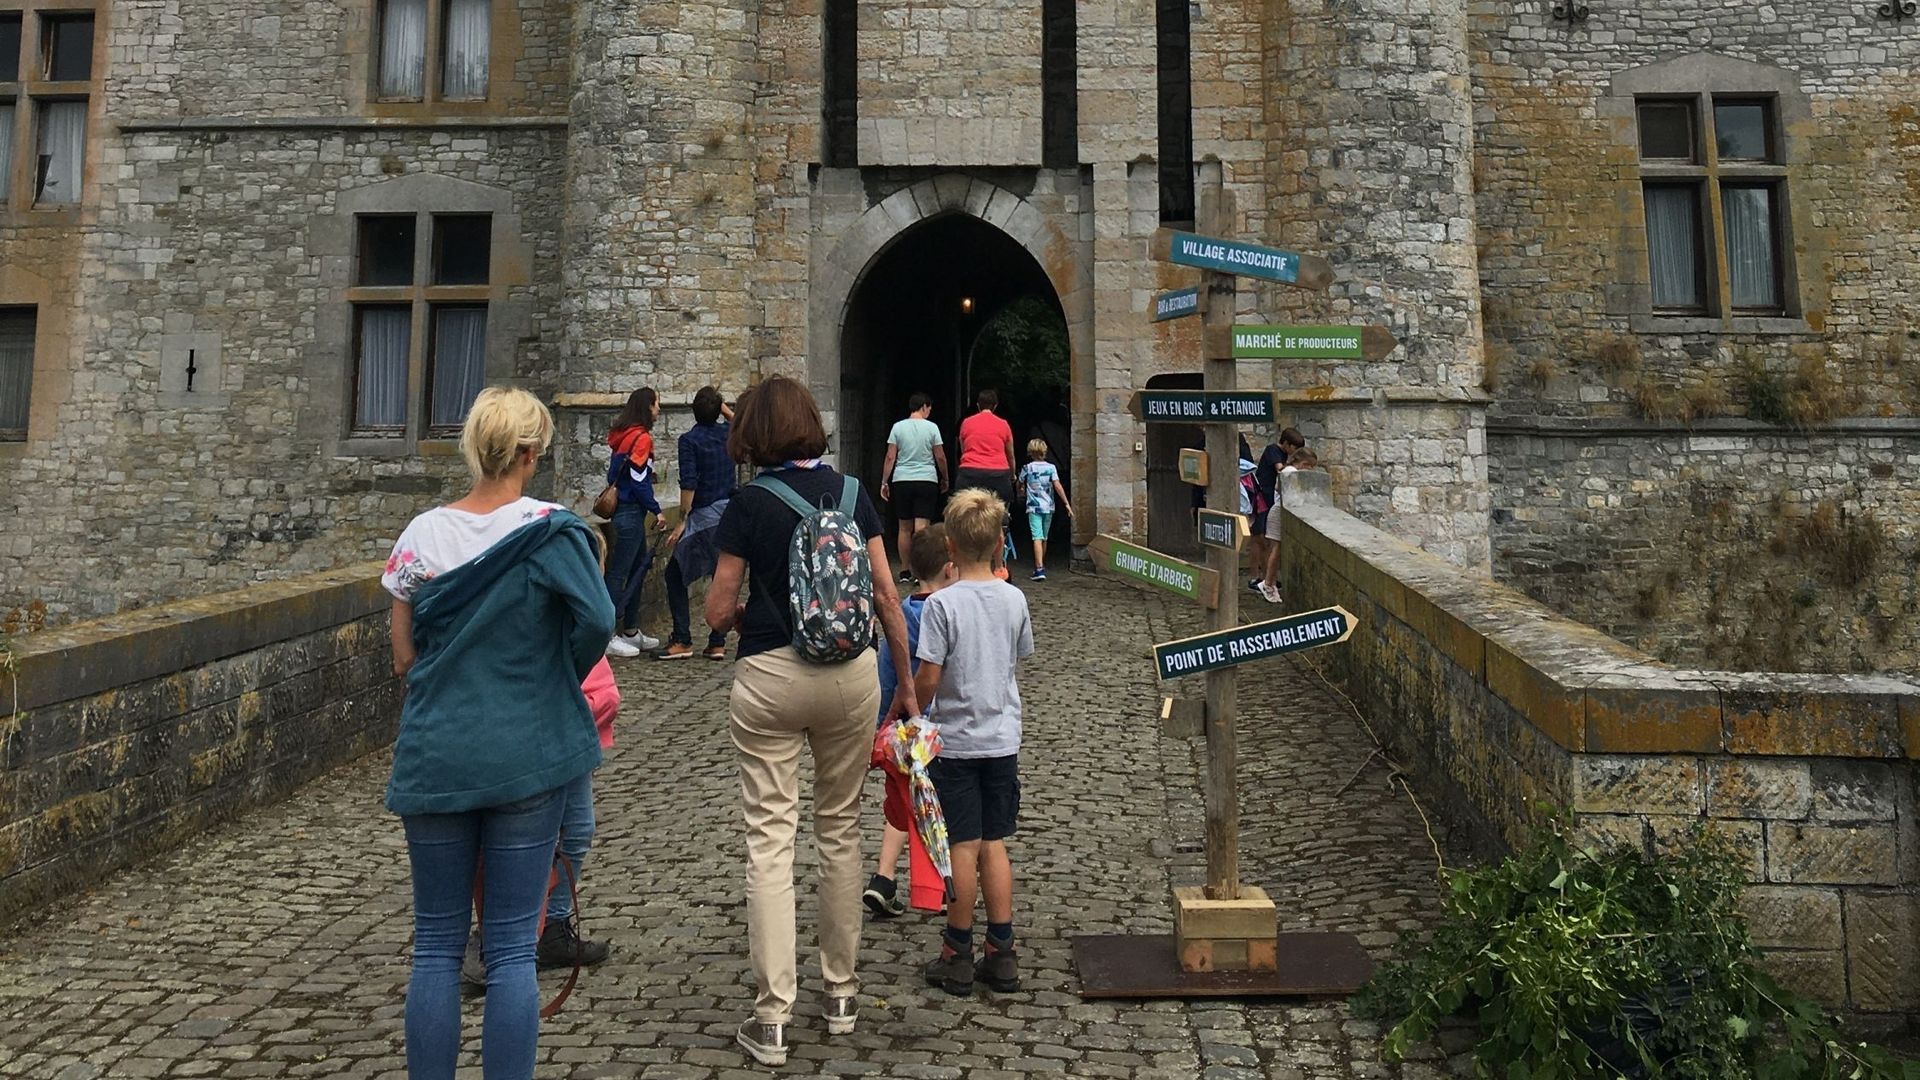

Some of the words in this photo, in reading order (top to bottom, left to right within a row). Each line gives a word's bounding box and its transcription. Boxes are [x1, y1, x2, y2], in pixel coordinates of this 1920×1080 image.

[1182, 240, 1225, 260] VILLAGE
[1227, 248, 1288, 271] ASSOCIATIF
[1235, 332, 1282, 349] MARCHÉ
[1285, 338, 1297, 349] DE
[1298, 338, 1358, 349] PRODUCTEURS
[1148, 400, 1168, 415] JEUX
[1169, 401, 1181, 415] EN
[1183, 401, 1204, 416] BOIS
[1210, 402, 1219, 415] &
[1220, 398, 1267, 416] PÉTANQUE
[1204, 522, 1224, 542] TOILETTES
[1115, 551, 1149, 576] GRIMPE
[1150, 562, 1193, 592] D'ARBRES
[1165, 648, 1204, 673] POINT
[1207, 643, 1226, 664] DE
[1229, 616, 1341, 659] RASSEMBLEMENT
